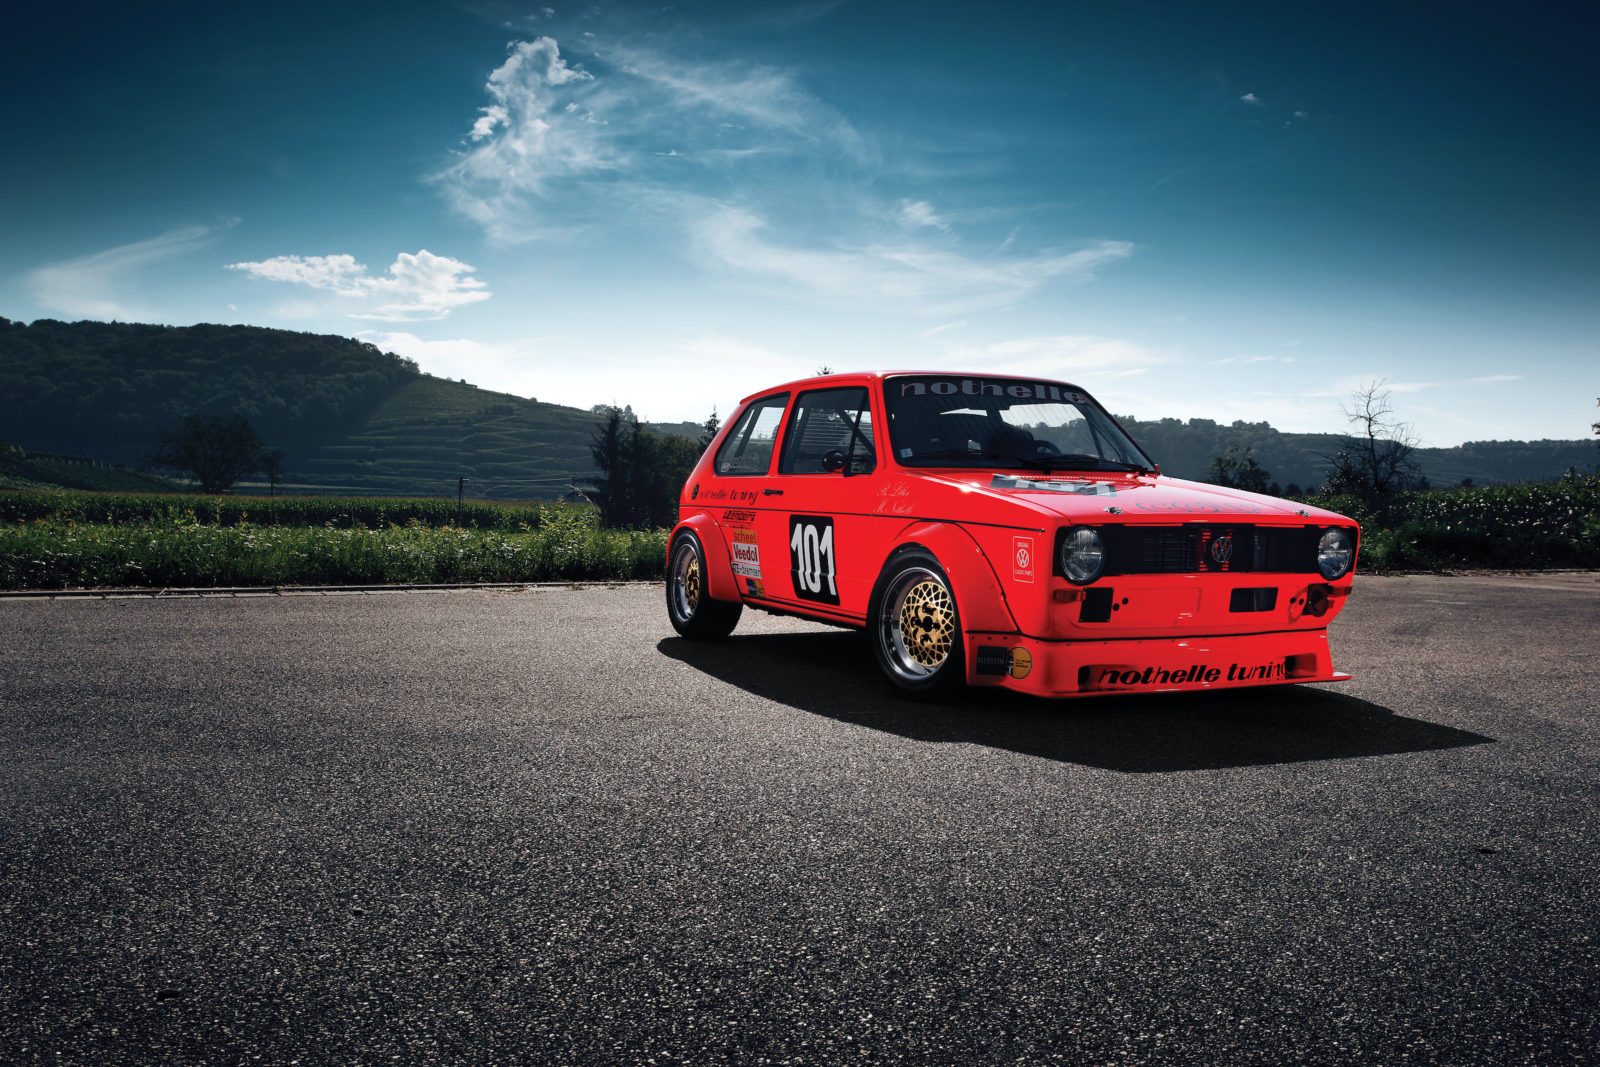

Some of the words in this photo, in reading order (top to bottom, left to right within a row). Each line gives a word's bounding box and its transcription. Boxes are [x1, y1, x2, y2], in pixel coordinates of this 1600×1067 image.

[901, 379, 1086, 404] nothelle
[734, 530, 757, 544] scheel
[733, 544, 758, 562] Veedol
[790, 523, 837, 596] 101
[1099, 664, 1221, 685] nothelle
